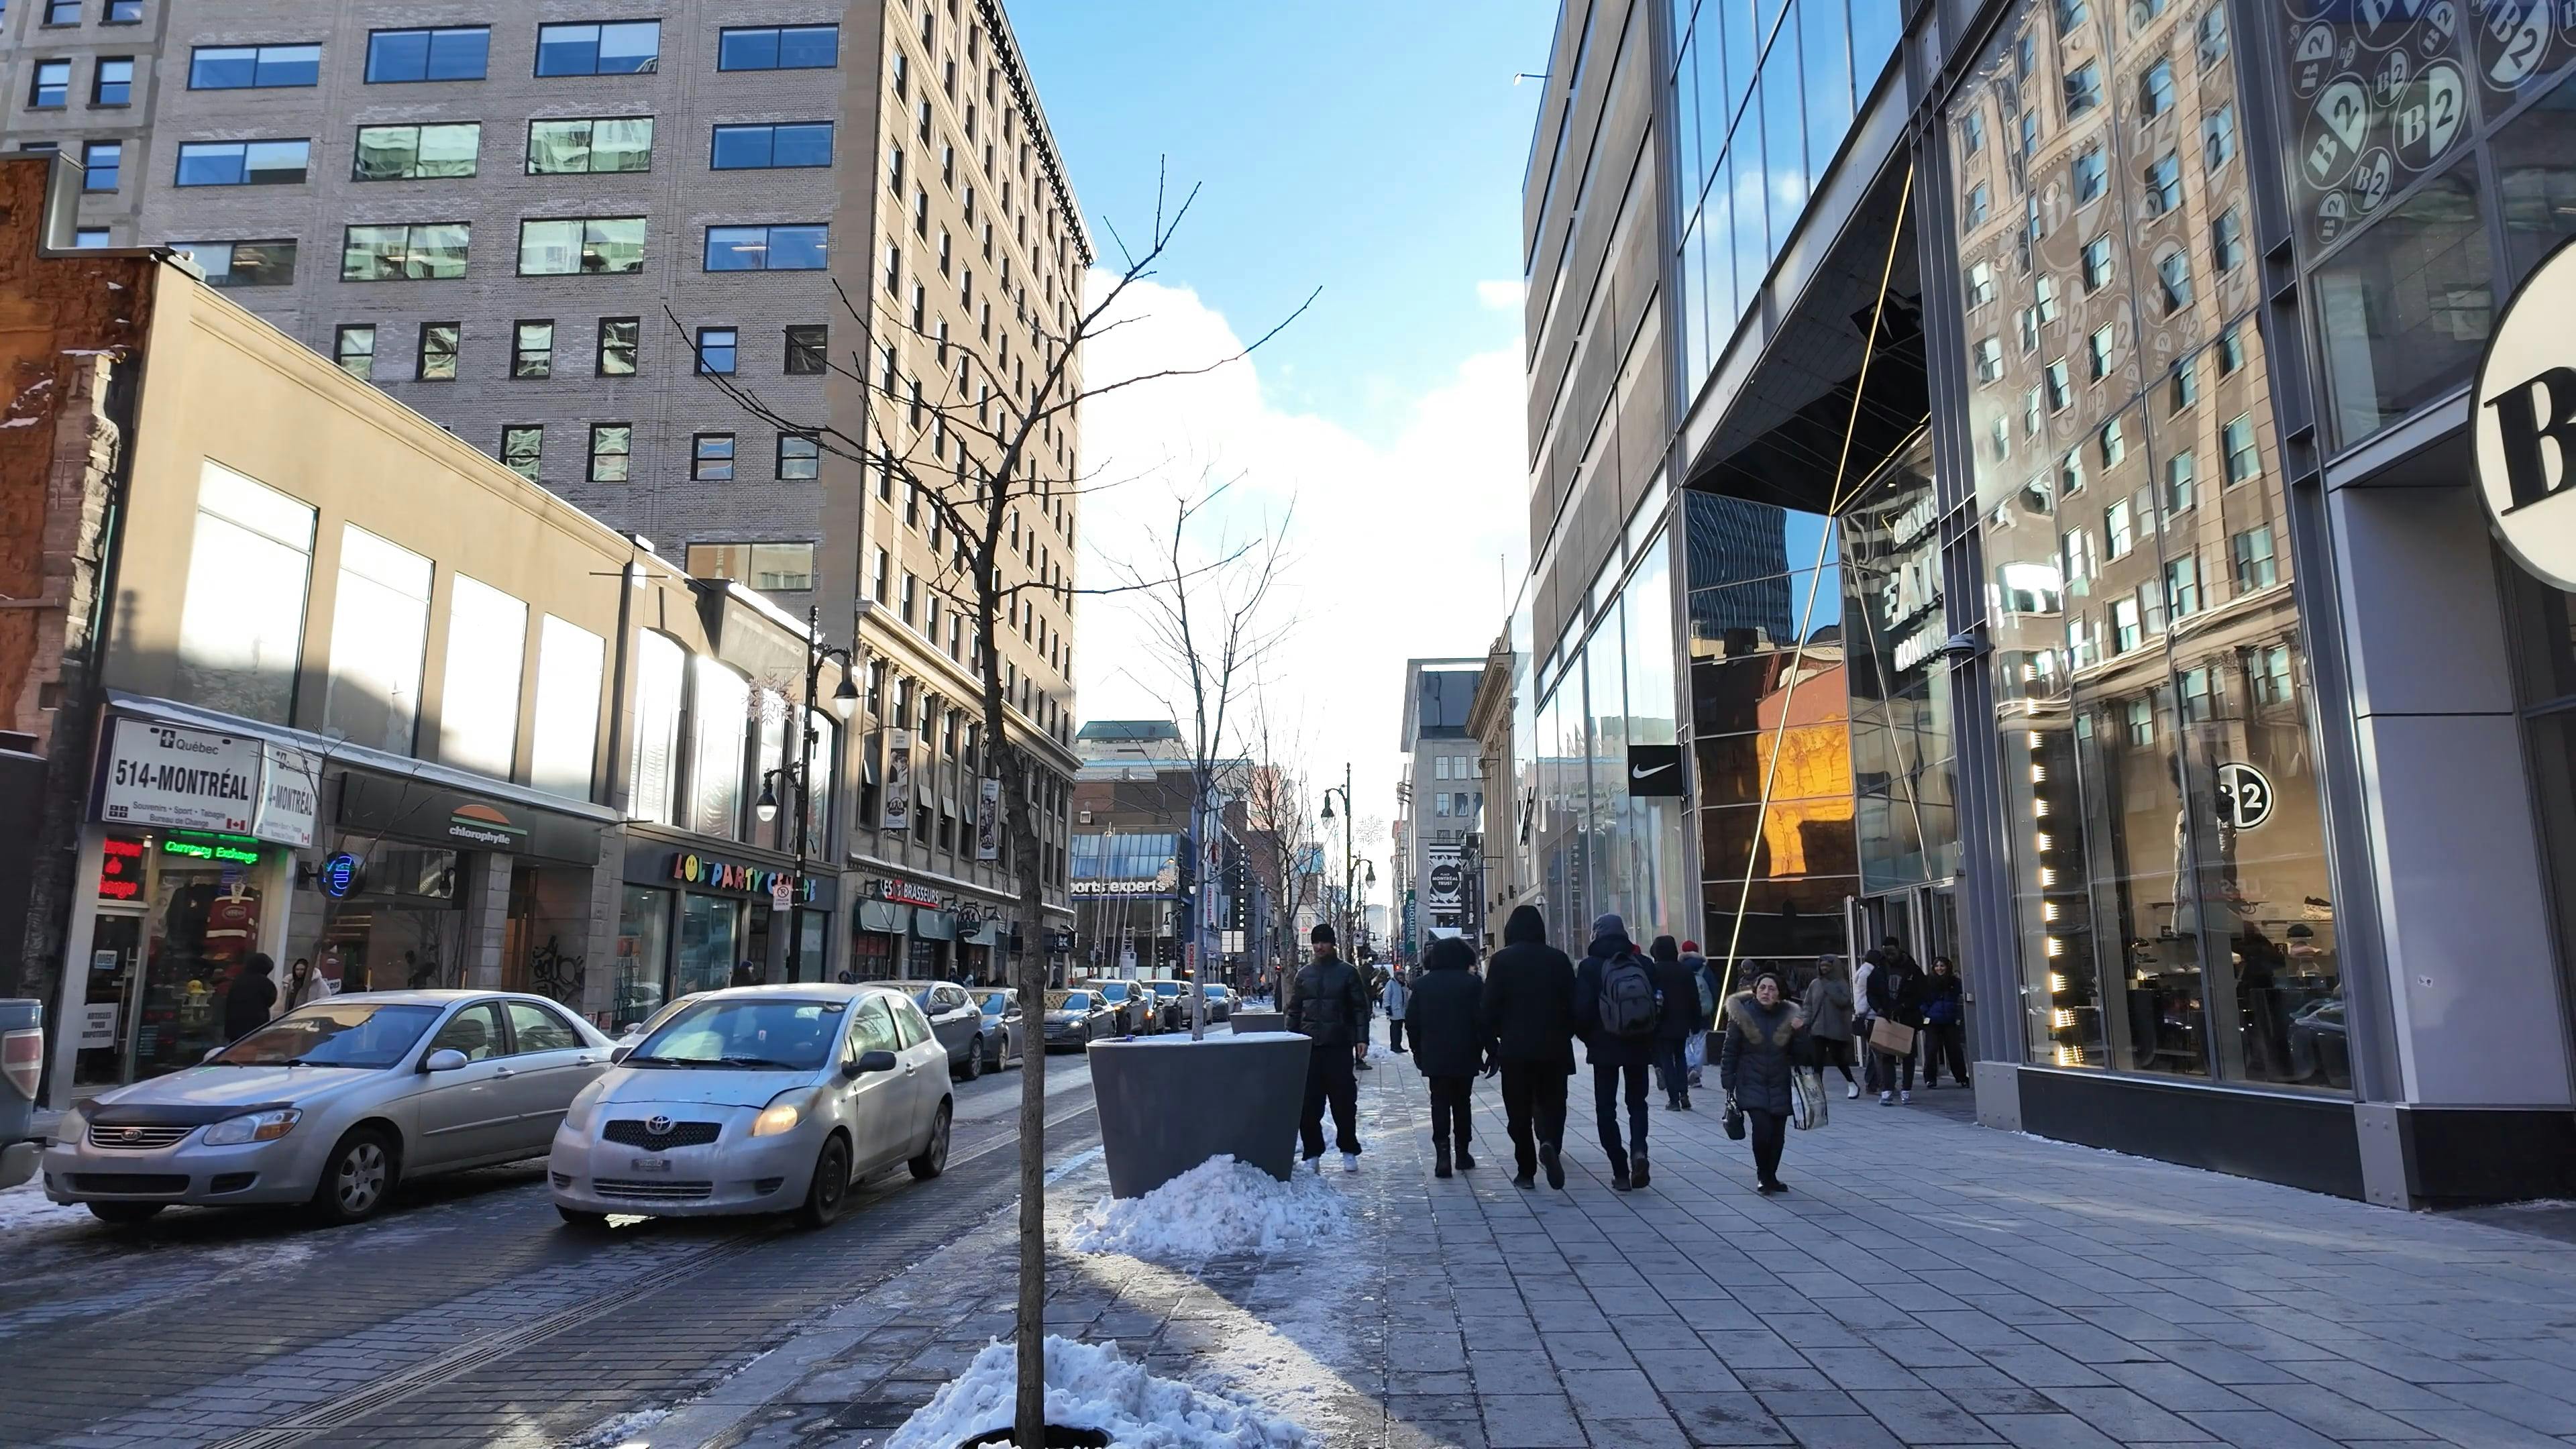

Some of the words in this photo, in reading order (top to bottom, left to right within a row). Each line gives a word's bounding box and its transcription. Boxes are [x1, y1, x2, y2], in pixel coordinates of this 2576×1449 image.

[2300, 34, 2325, 91] B2
[2377, 63, 2404, 96] B2
[2400, 89, 2454, 150] B2
[2307, 95, 2360, 181] B2
[2353, 165, 2385, 196] B2
[2321, 199, 2341, 237] B2
[1894, 495, 1938, 543] CENTR
[176, 739, 219, 755] Québec
[116, 759, 248, 800] 514-MONTRÉAL
[133, 801, 167, 812] Souvenirs
[174, 806, 193, 816] Sport
[150, 814, 174, 823] Bureau
[175, 816, 184, 824] de
[185, 817, 209, 828] Change
[449, 826, 510, 844] chlorophylle
[711, 863, 764, 892] PARTY
[1110, 879, 1167, 894] experts
[904, 883, 939, 904] BRASSEURS
